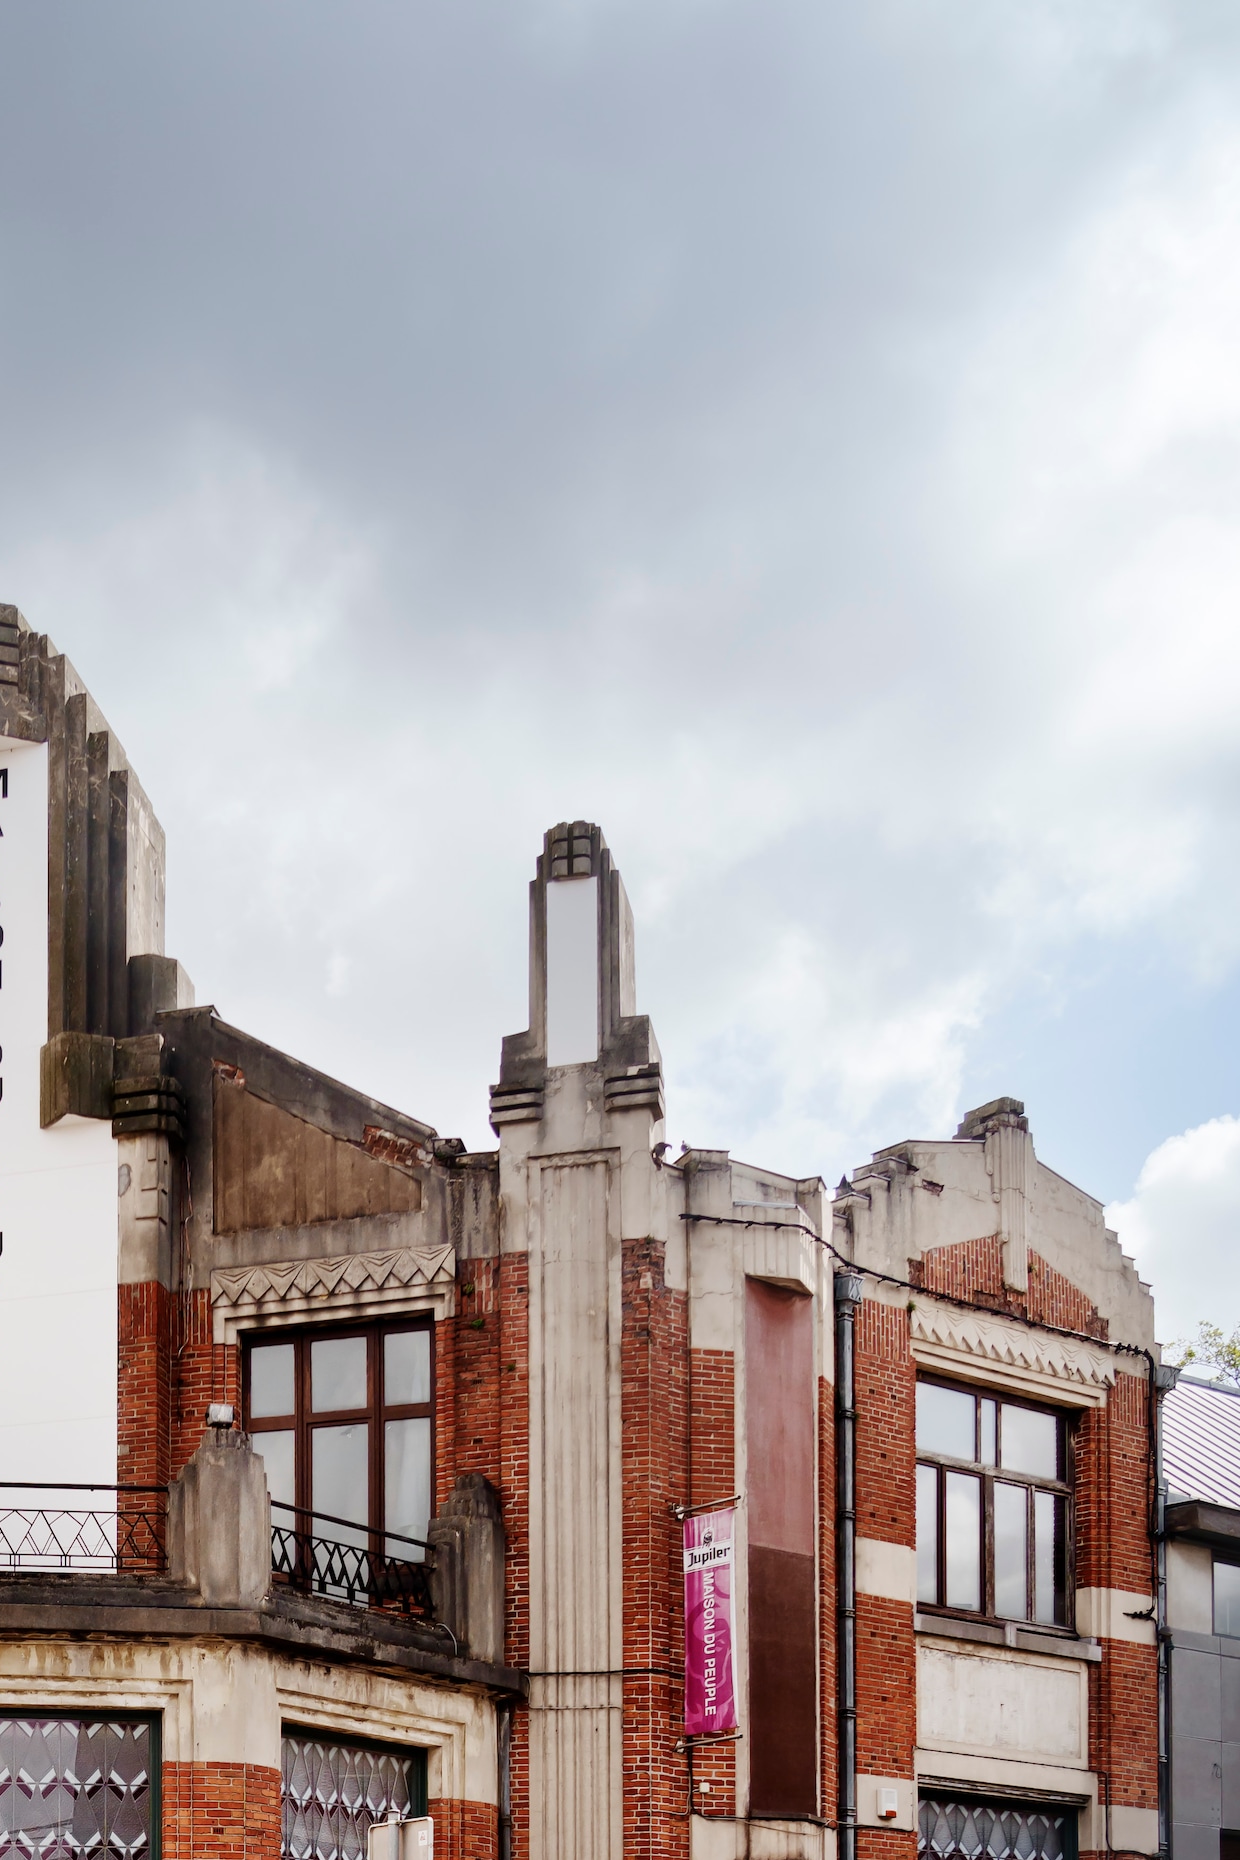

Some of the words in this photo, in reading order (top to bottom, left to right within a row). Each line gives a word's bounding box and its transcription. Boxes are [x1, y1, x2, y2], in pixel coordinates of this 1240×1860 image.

[688, 1546, 730, 1567] Jupiler
[703, 1571, 716, 1631] MAISON
[703, 1634, 716, 1655] DU
[704, 1659, 717, 1716] PEUPLE
